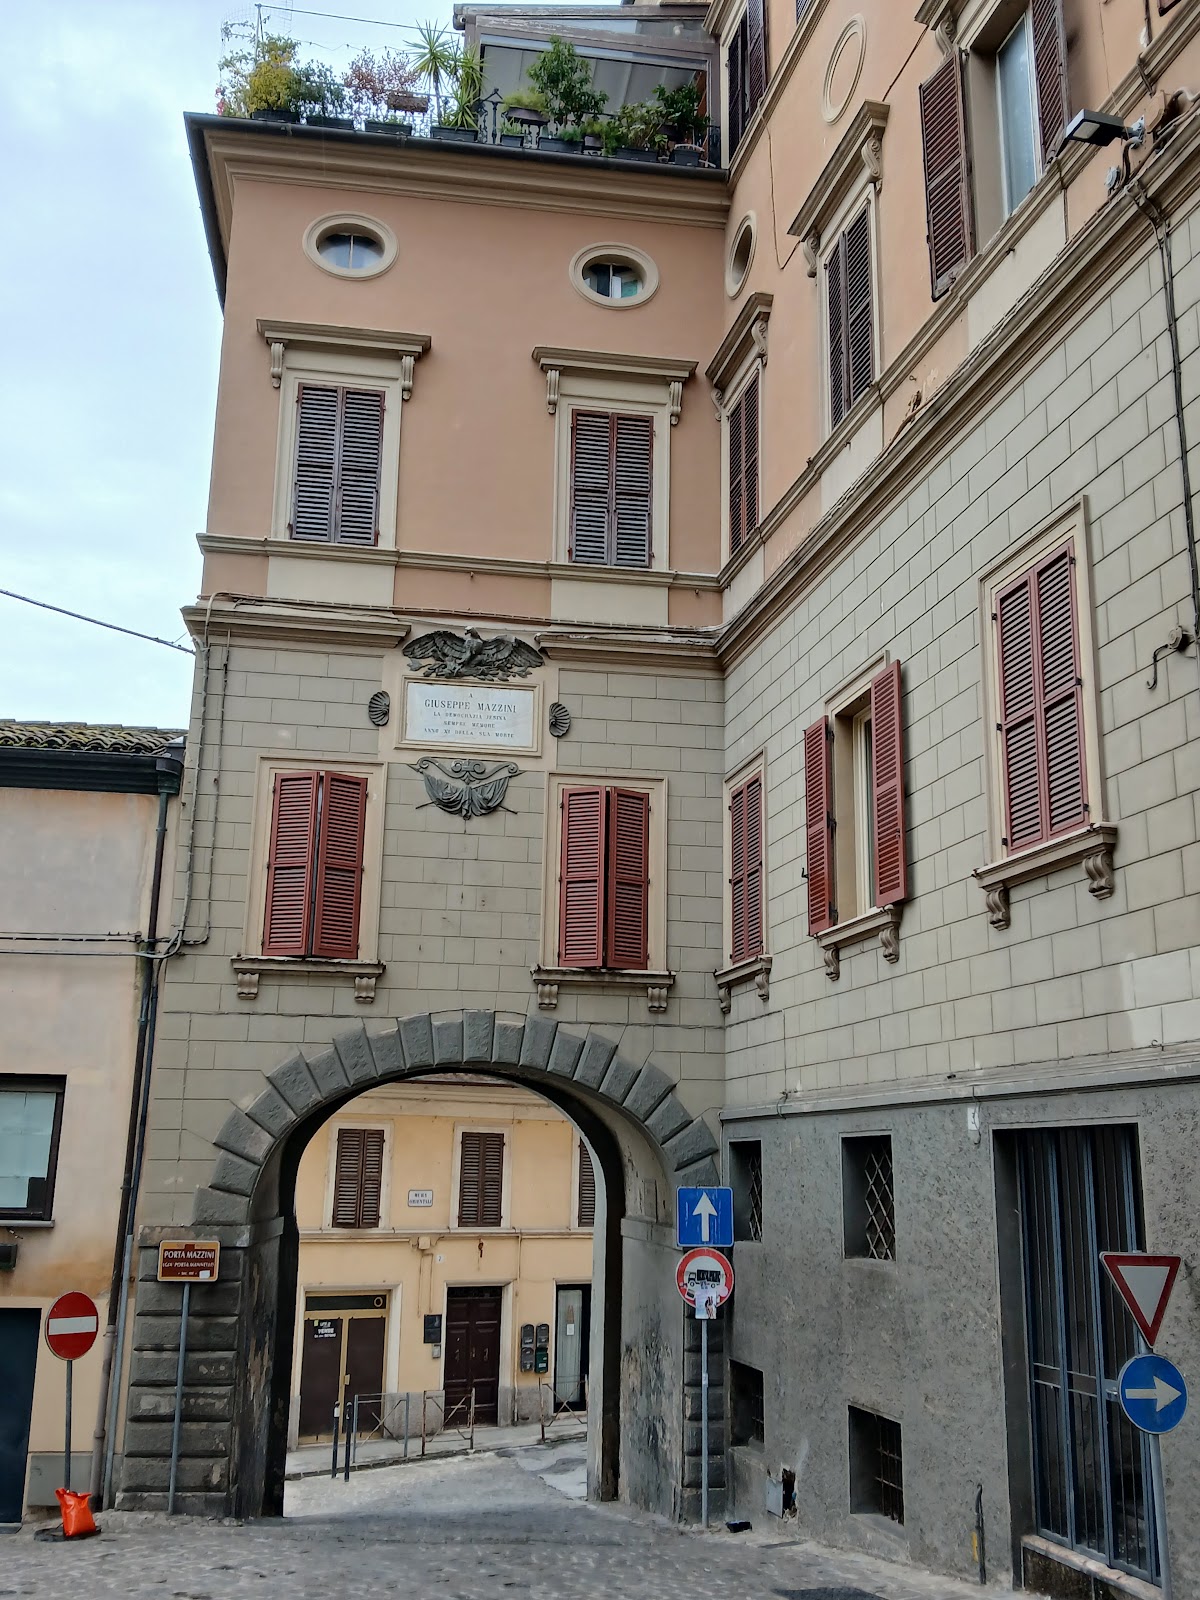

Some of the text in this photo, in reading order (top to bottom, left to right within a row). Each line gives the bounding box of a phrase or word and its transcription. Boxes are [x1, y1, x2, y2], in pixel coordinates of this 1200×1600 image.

[424, 699, 517, 713] GIUSEPPE MAZZINI
[164, 1250, 215, 1259] PORTA MAZZINI
